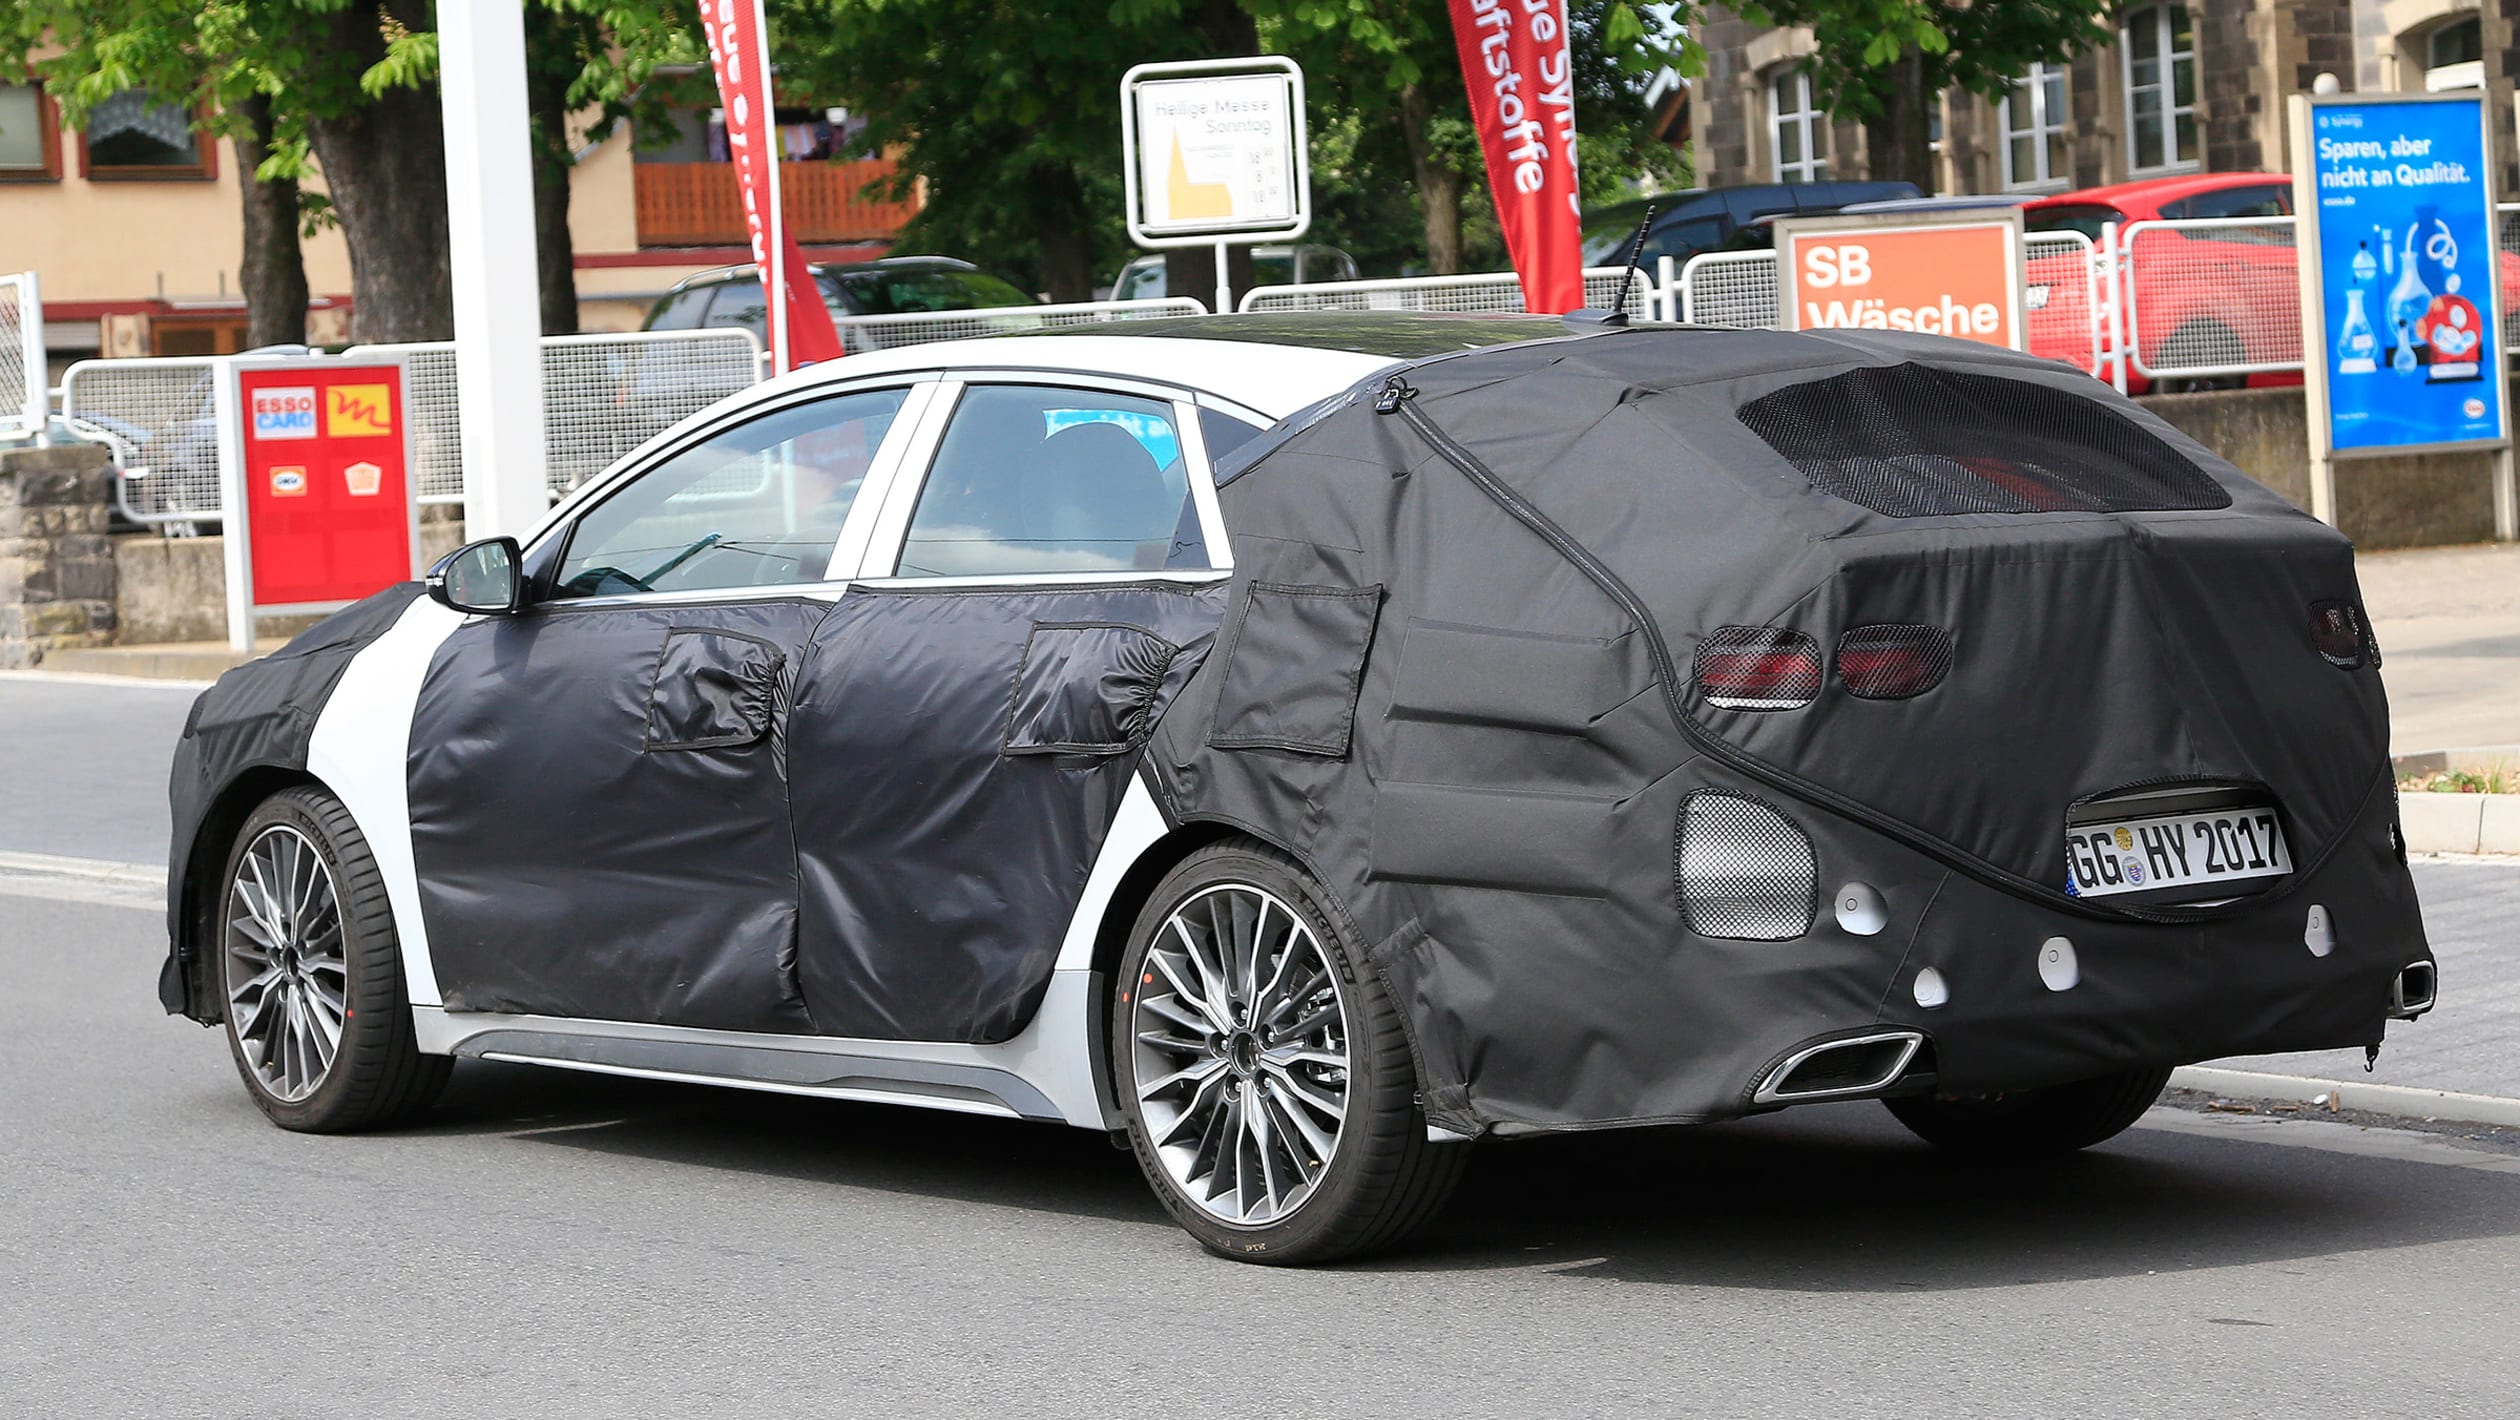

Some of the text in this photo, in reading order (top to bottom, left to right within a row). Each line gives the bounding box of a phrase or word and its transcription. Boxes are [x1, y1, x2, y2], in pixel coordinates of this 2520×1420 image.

[1154, 98, 1270, 119] Heilige Messe
[1205, 118, 1272, 135] Sonntag
[2319, 134, 2431, 164] Sparen, aber
[2322, 162, 2471, 188] nicht an Qualität.
[1805, 245, 1872, 288] SB
[1806, 294, 1999, 336] Wäsche
[255, 397, 312, 413] ESSO
[257, 412, 312, 430] CARD
[2069, 814, 2279, 888] GG HY 2017
[1302, 895, 1357, 985] MICHELIN
